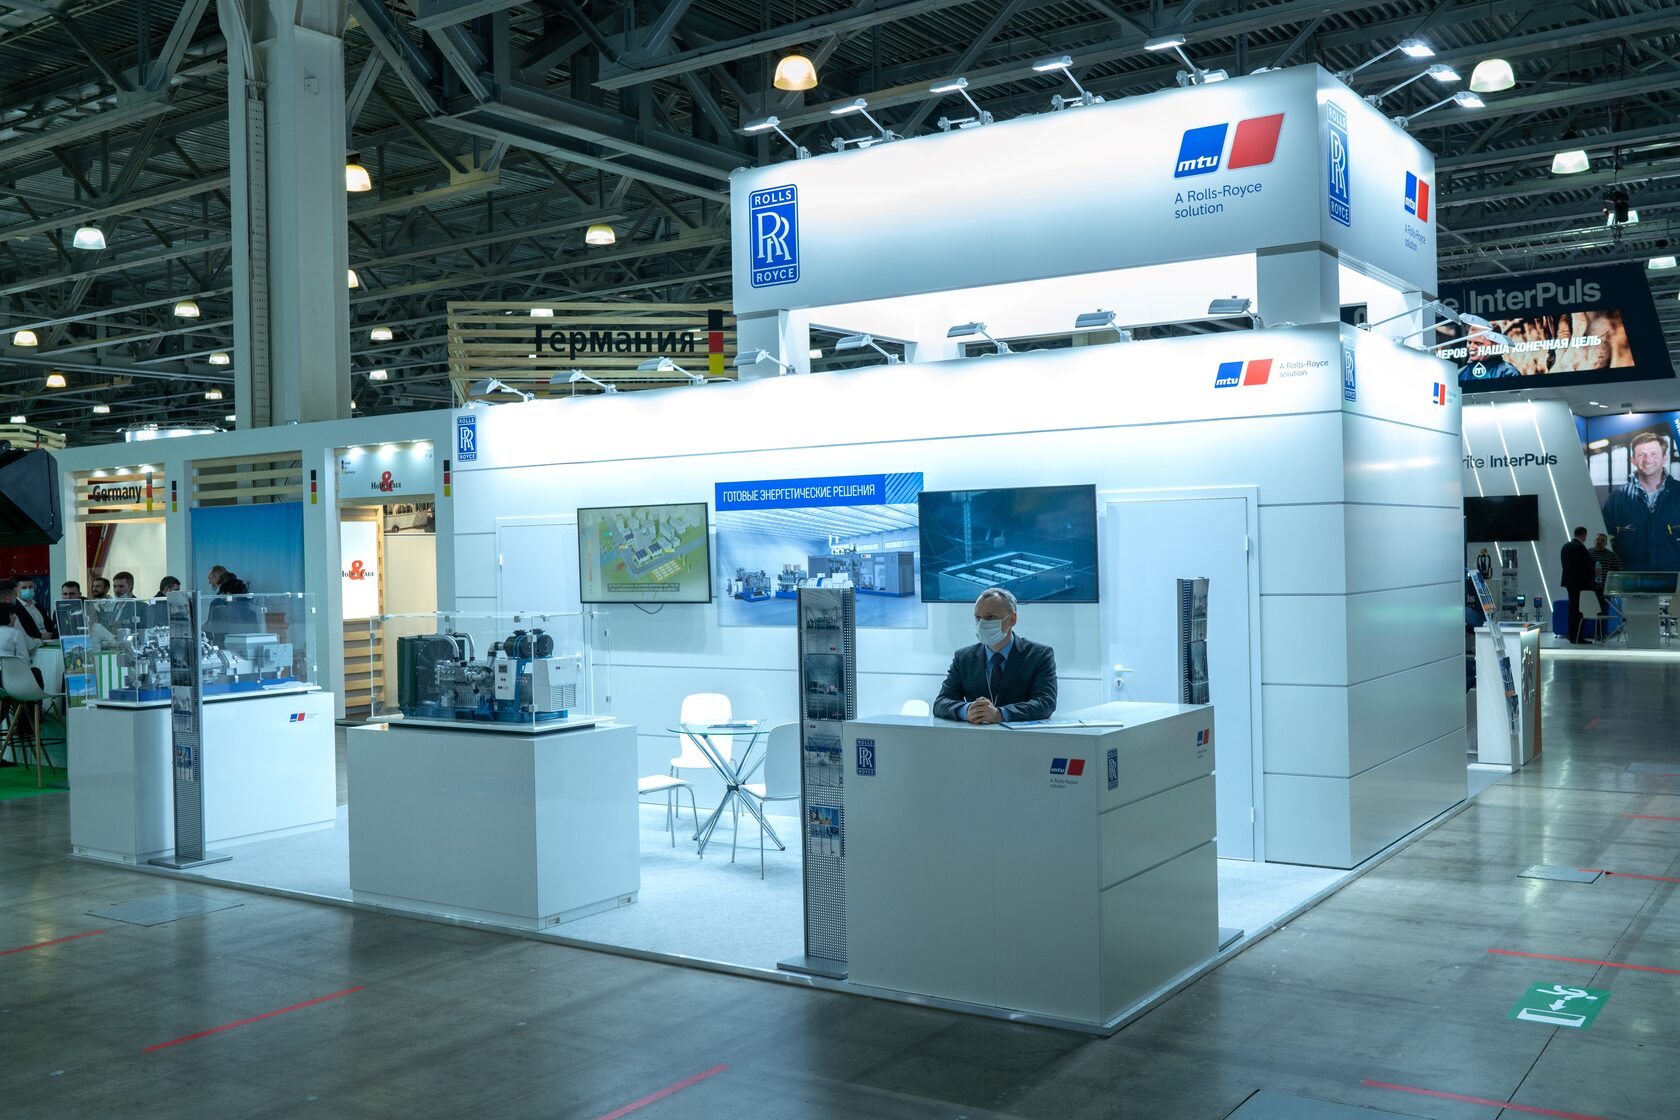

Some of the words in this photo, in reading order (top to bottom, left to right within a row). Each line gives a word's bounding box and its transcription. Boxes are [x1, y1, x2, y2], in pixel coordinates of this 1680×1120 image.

[1328, 106, 1346, 128] ROLLS
[1177, 155, 1218, 172] mtu
[754, 190, 792, 206] ROLLS
[1174, 193, 1184, 204] A
[1187, 183, 1262, 202] Rolls-Royce
[1174, 203, 1224, 219] solution
[1330, 201, 1349, 220] ROYCE
[756, 268, 795, 283] ROYCE
[1470, 278, 1601, 314] InterPuls
[535, 324, 695, 361] Германия
[1477, 345, 1509, 356] НАША
[1512, 338, 1569, 353] КОНЕЧНАЯ
[1571, 335, 1602, 349] ЦЕЛЬ
[1286, 359, 1329, 369] Rolls-Royce
[1216, 377, 1239, 386] mtu
[1279, 369, 1308, 378] solution
[1490, 452, 1558, 468] InterPuls
[93, 485, 142, 504] Germany
[723, 489, 759, 503] ГОТОВЫЕ
[759, 485, 832, 501] ЭНЕРГЕТИЧЕСКИЕ
[833, 484, 876, 498] РЕШЕНИЯ
